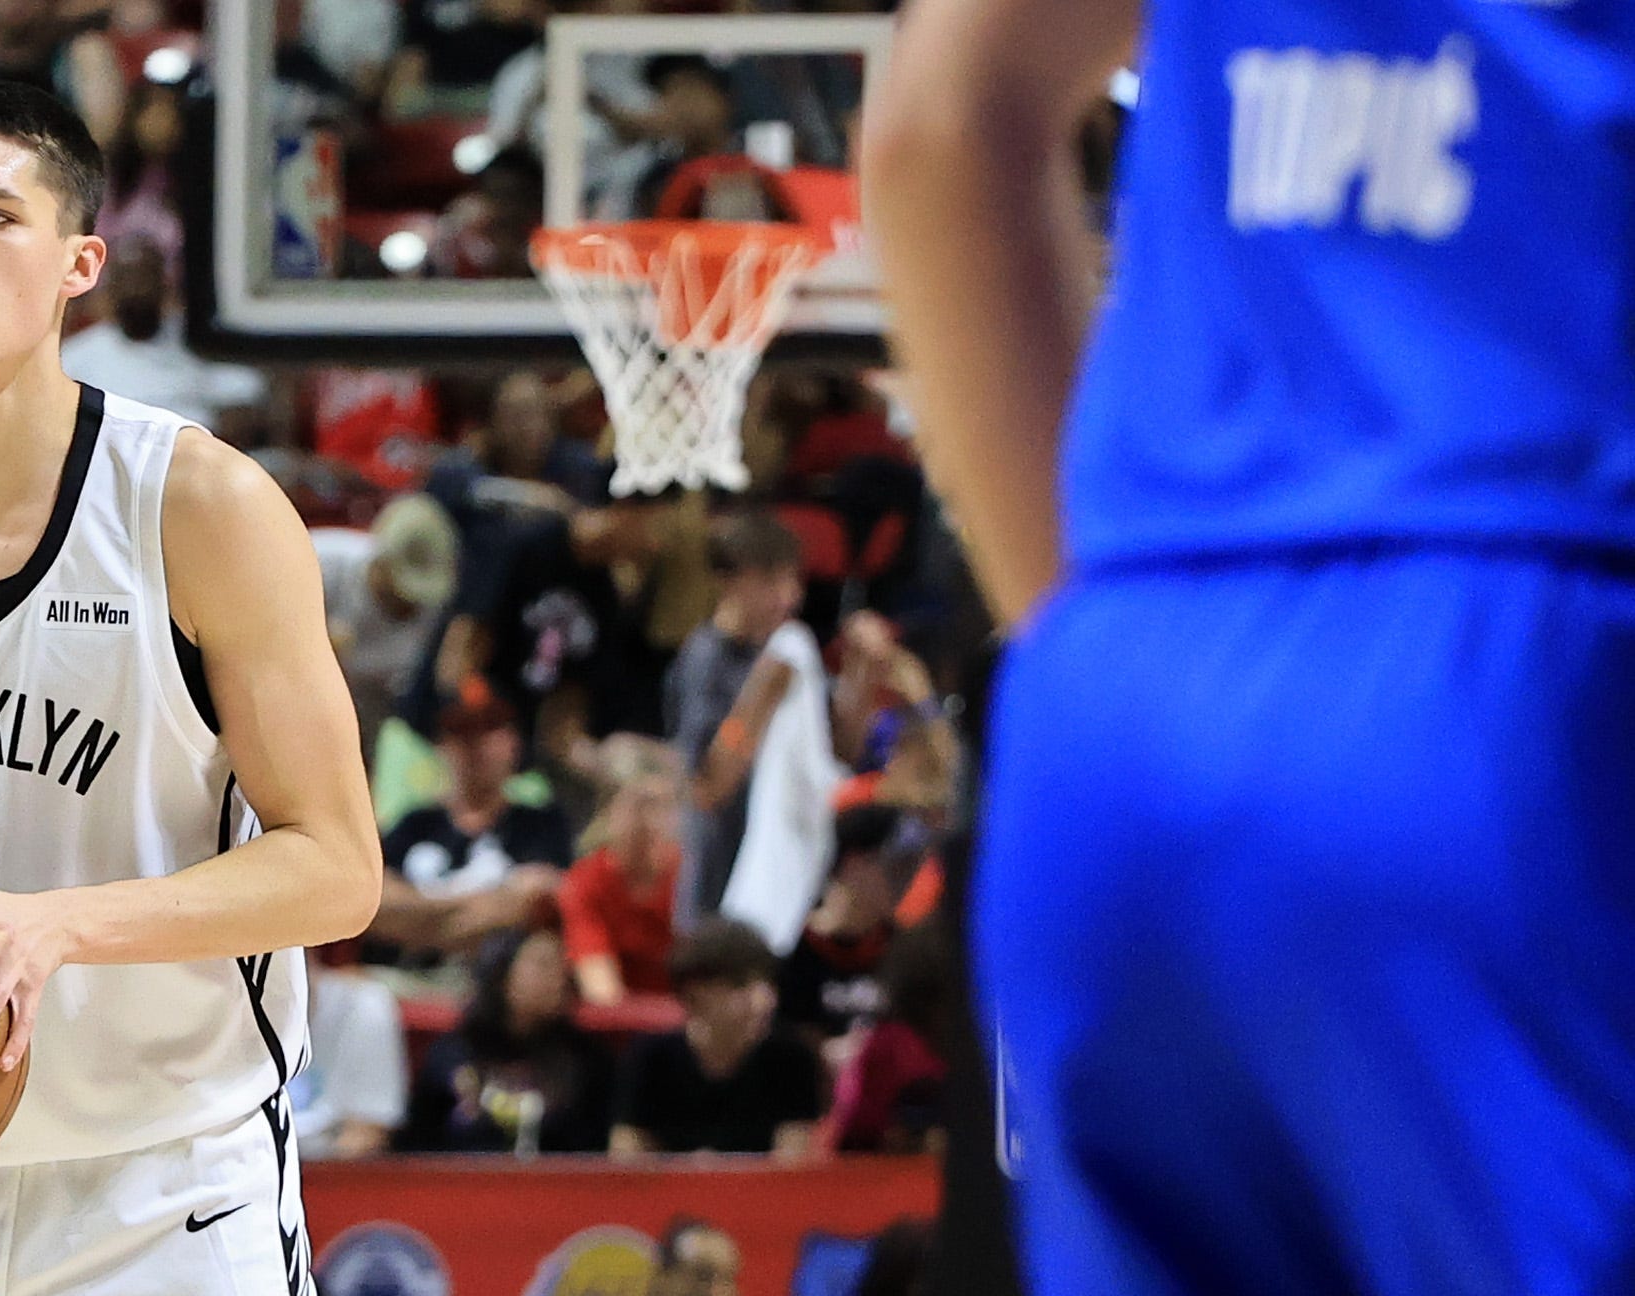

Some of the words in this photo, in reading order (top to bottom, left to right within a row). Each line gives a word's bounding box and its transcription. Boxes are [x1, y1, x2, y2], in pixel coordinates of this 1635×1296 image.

[46, 600, 69, 623] All
[74, 601, 90, 623] In
[93, 602, 129, 625] Won
